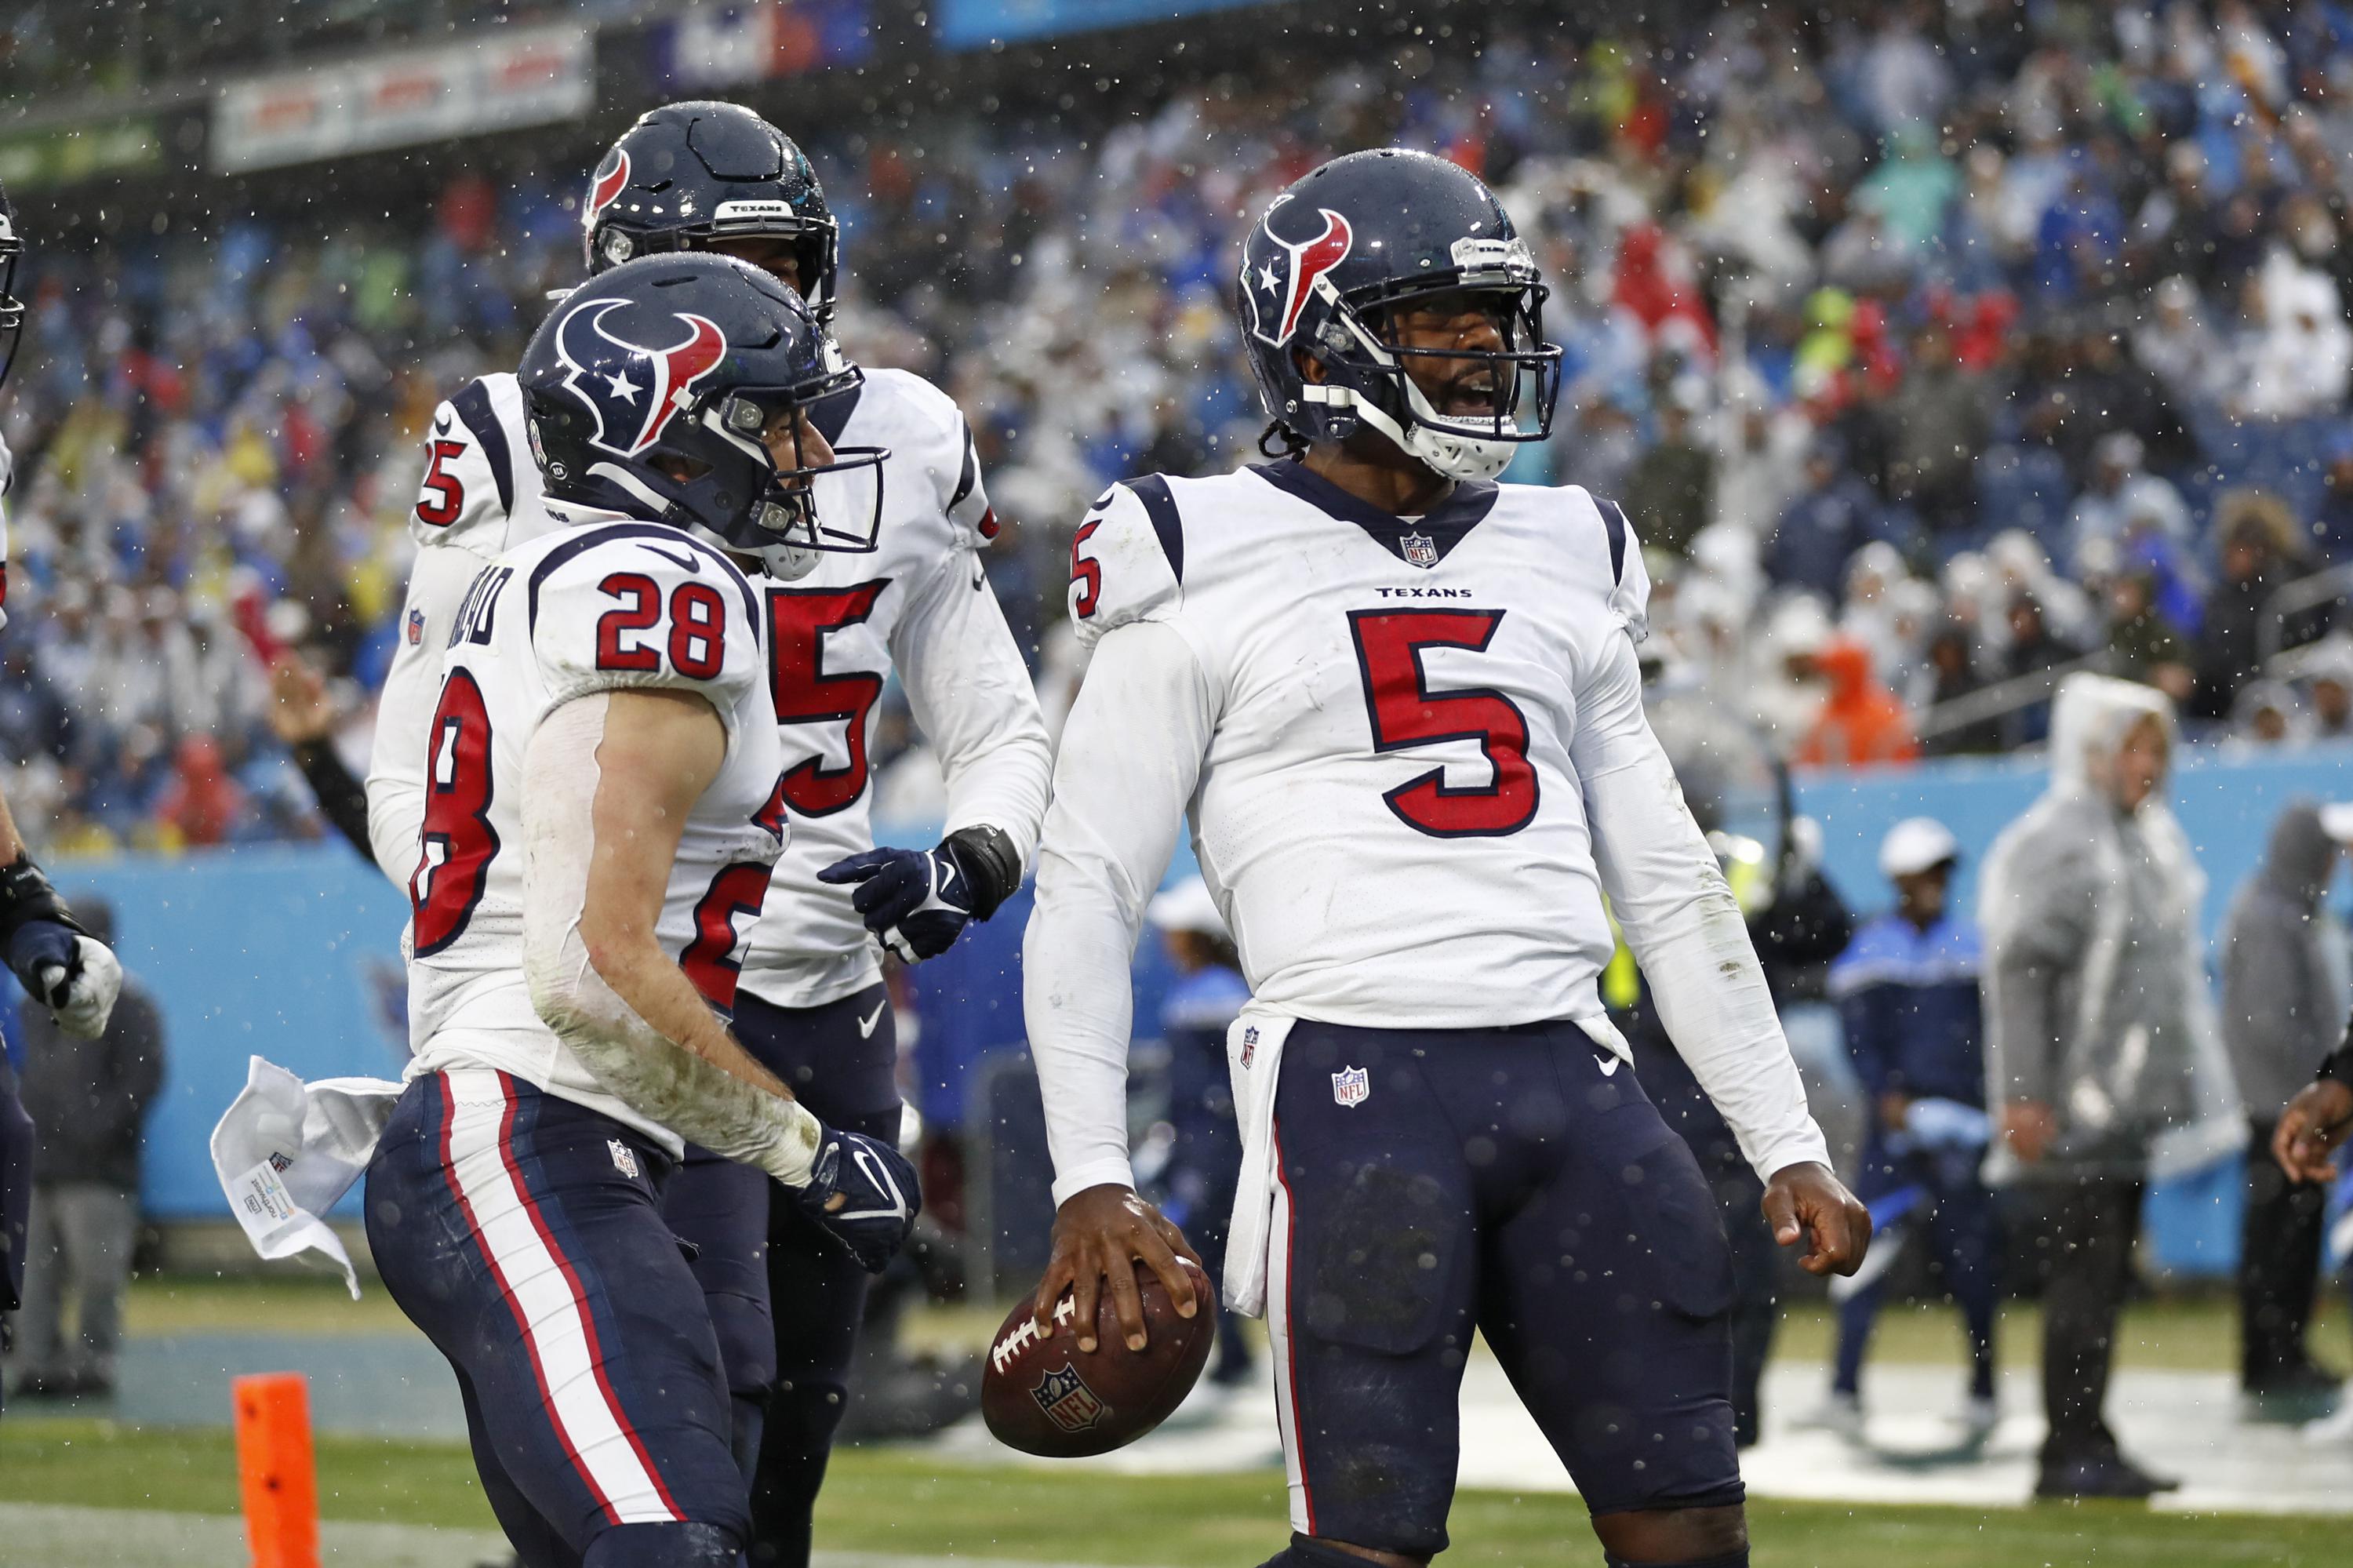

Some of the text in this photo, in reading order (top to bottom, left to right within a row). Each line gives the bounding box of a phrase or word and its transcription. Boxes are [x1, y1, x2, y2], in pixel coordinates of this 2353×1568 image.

[416, 439, 468, 527] 5
[1069, 518, 1104, 620] 5
[1374, 588, 1472, 598] TEXANS
[596, 572, 726, 680] 28
[1346, 607, 1540, 839] 5
[251, 1178, 278, 1218] northwest
[1050, 1391, 1099, 1428] NFL
